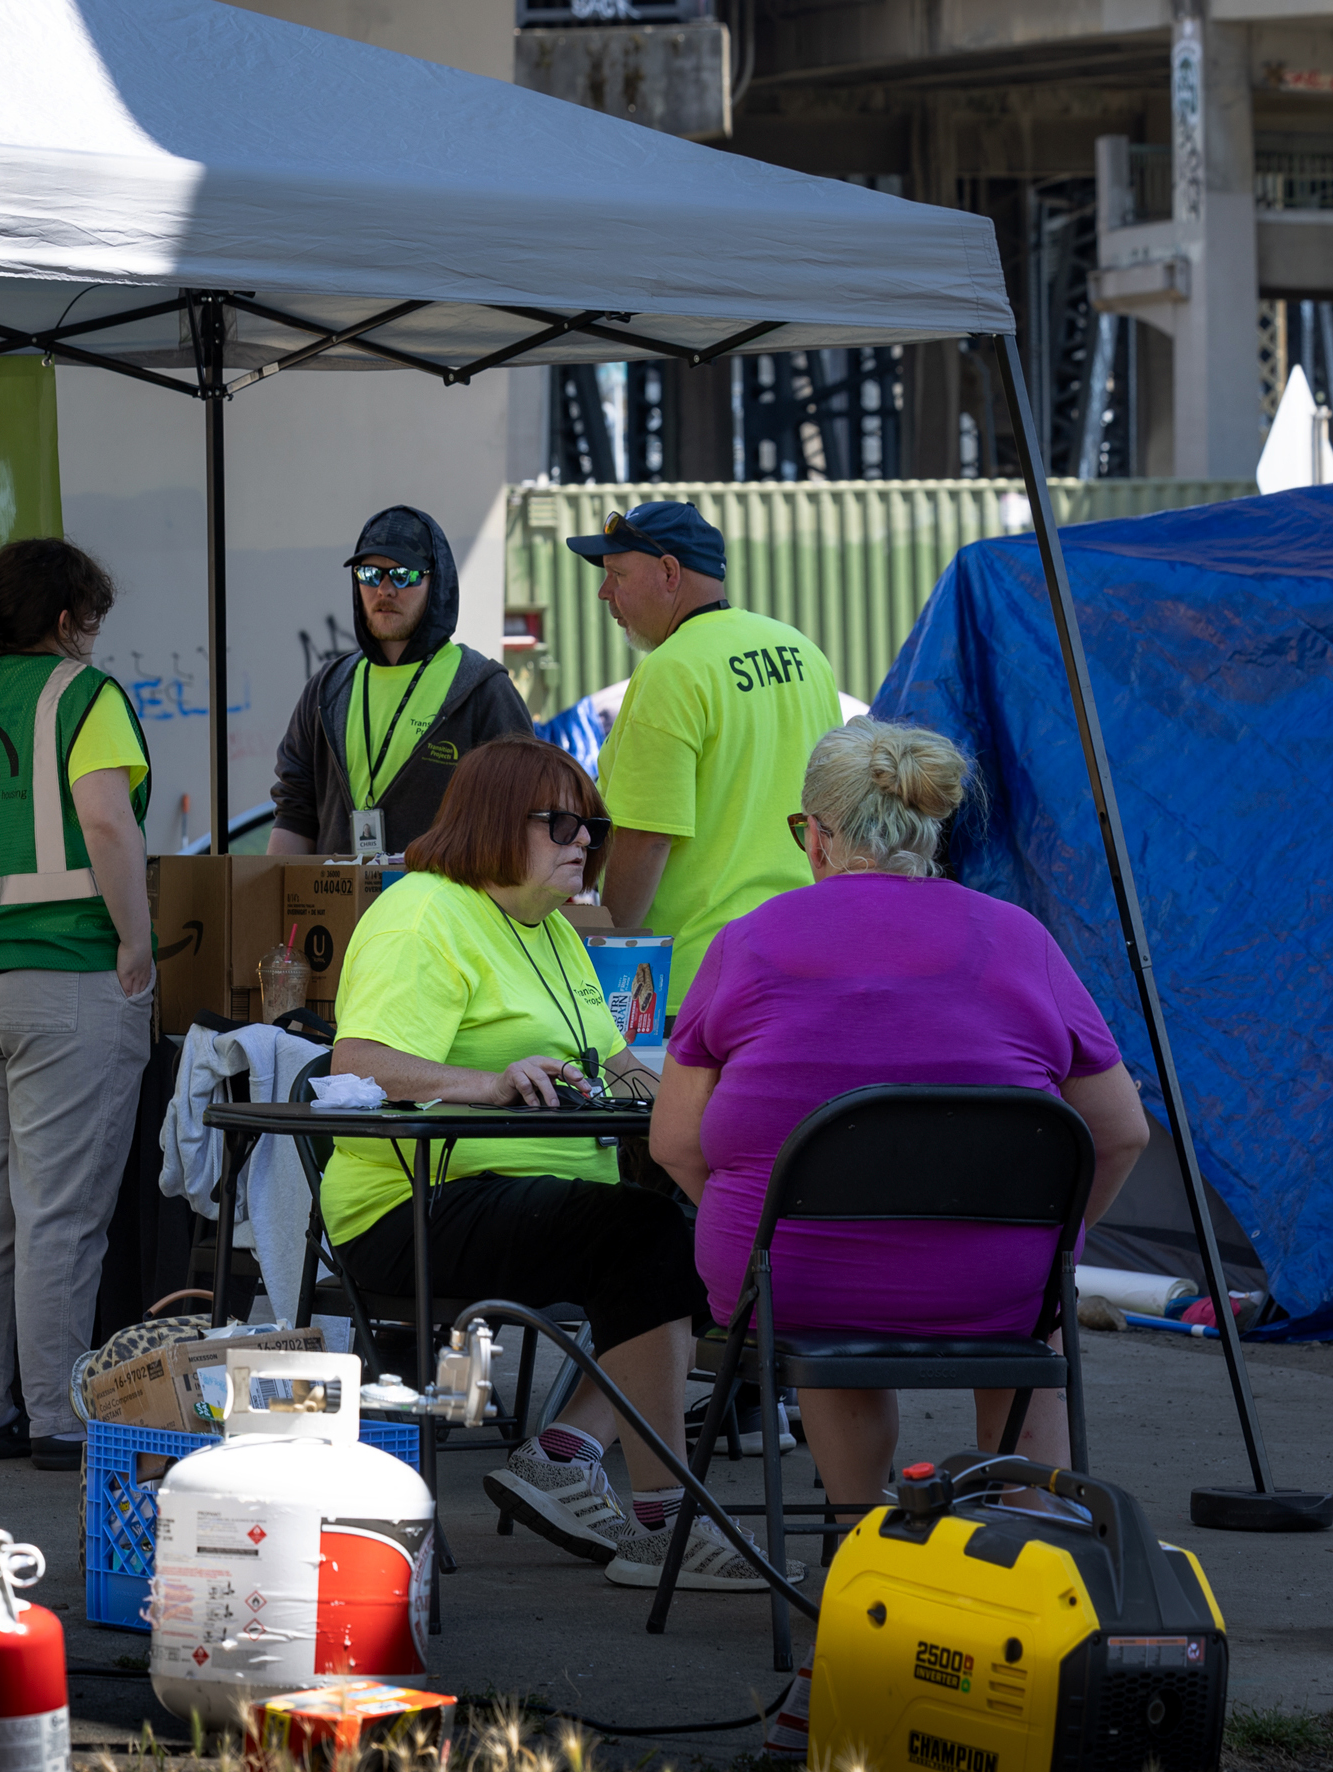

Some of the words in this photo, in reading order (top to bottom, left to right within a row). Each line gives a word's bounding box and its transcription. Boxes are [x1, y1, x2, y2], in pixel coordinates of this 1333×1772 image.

[729, 646, 804, 692] STAFF
[410, 719, 432, 728] Trans
[326, 870, 340, 878] 36000
[610, 996, 620, 1022] UTRI
[617, 996, 628, 1032] GRAIN
[114, 1366, 147, 1389] 16-9702
[99, 1400, 112, 1412] Cold
[915, 1641, 964, 1673] 2500
[916, 1665, 959, 1688] INVERTER
[909, 1732, 998, 1772] CHAMPION
